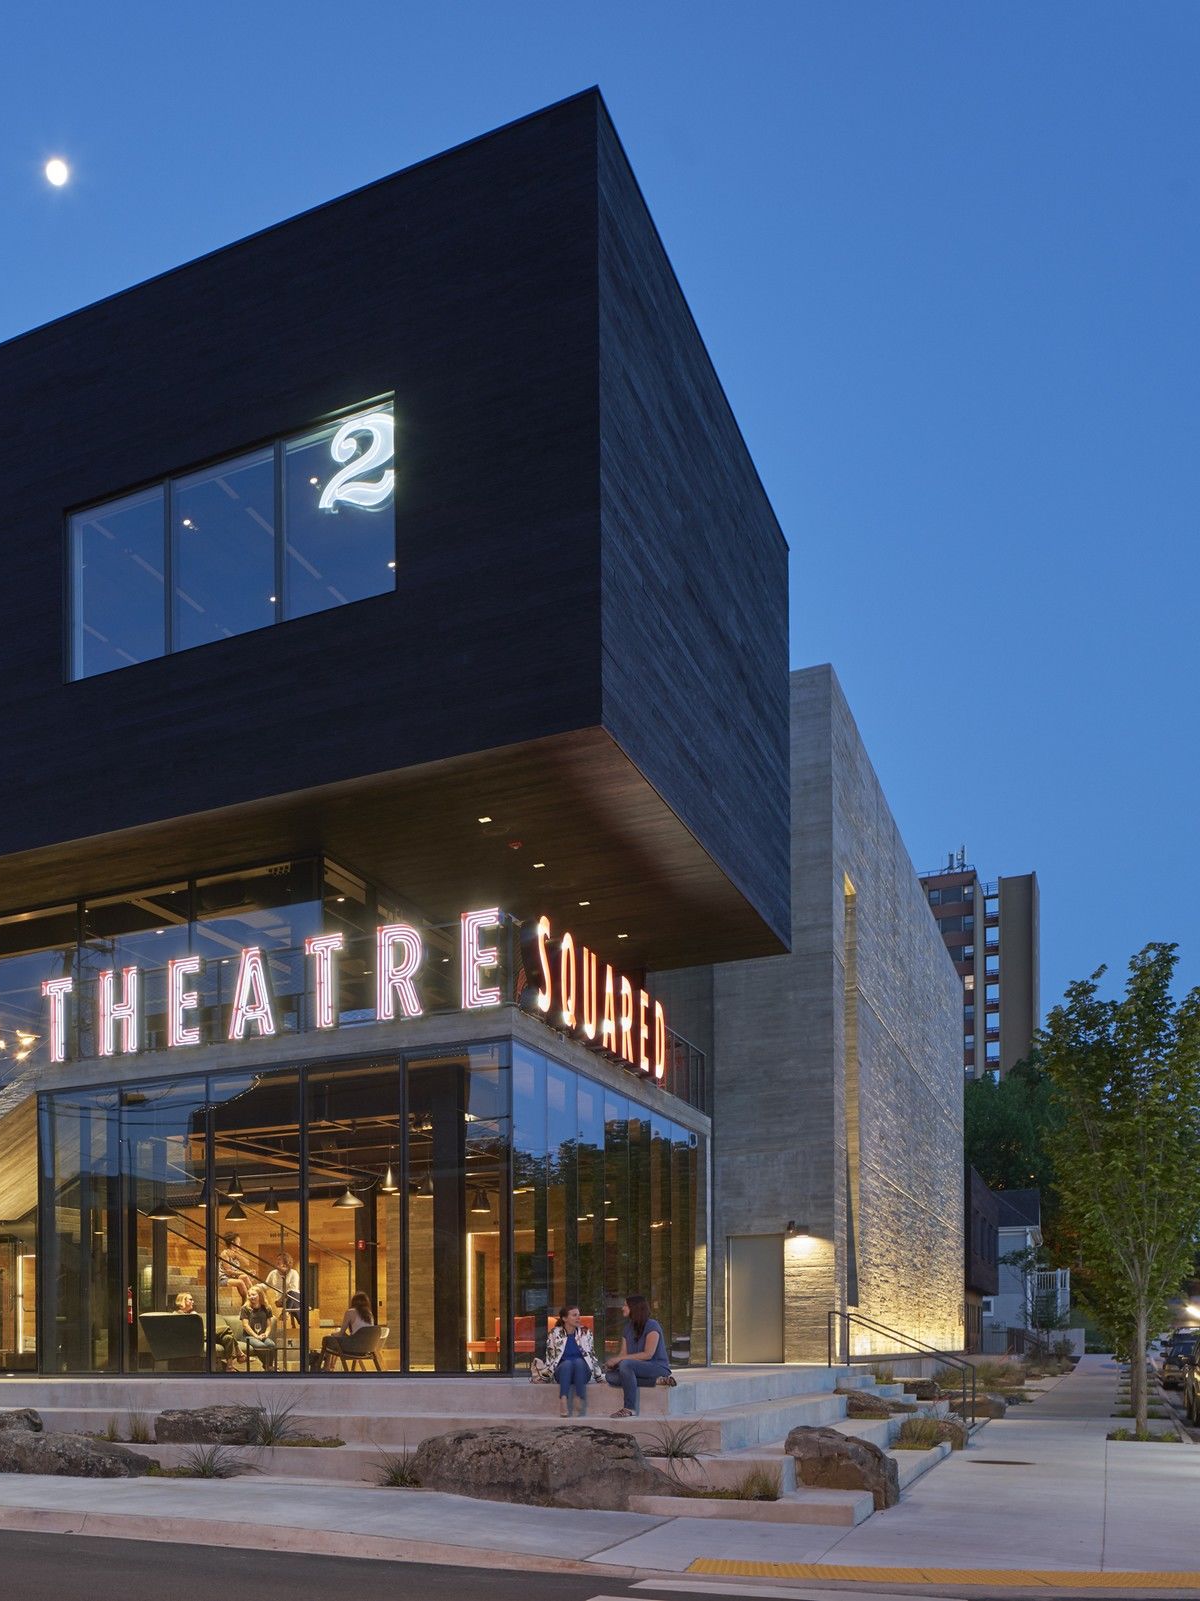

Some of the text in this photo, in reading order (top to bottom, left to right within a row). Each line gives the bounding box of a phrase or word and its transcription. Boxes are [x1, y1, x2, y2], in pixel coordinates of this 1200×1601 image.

[318, 412, 395, 512] 2
[41, 907, 501, 1063] THEATRE
[537, 915, 666, 1079] SQUARED
